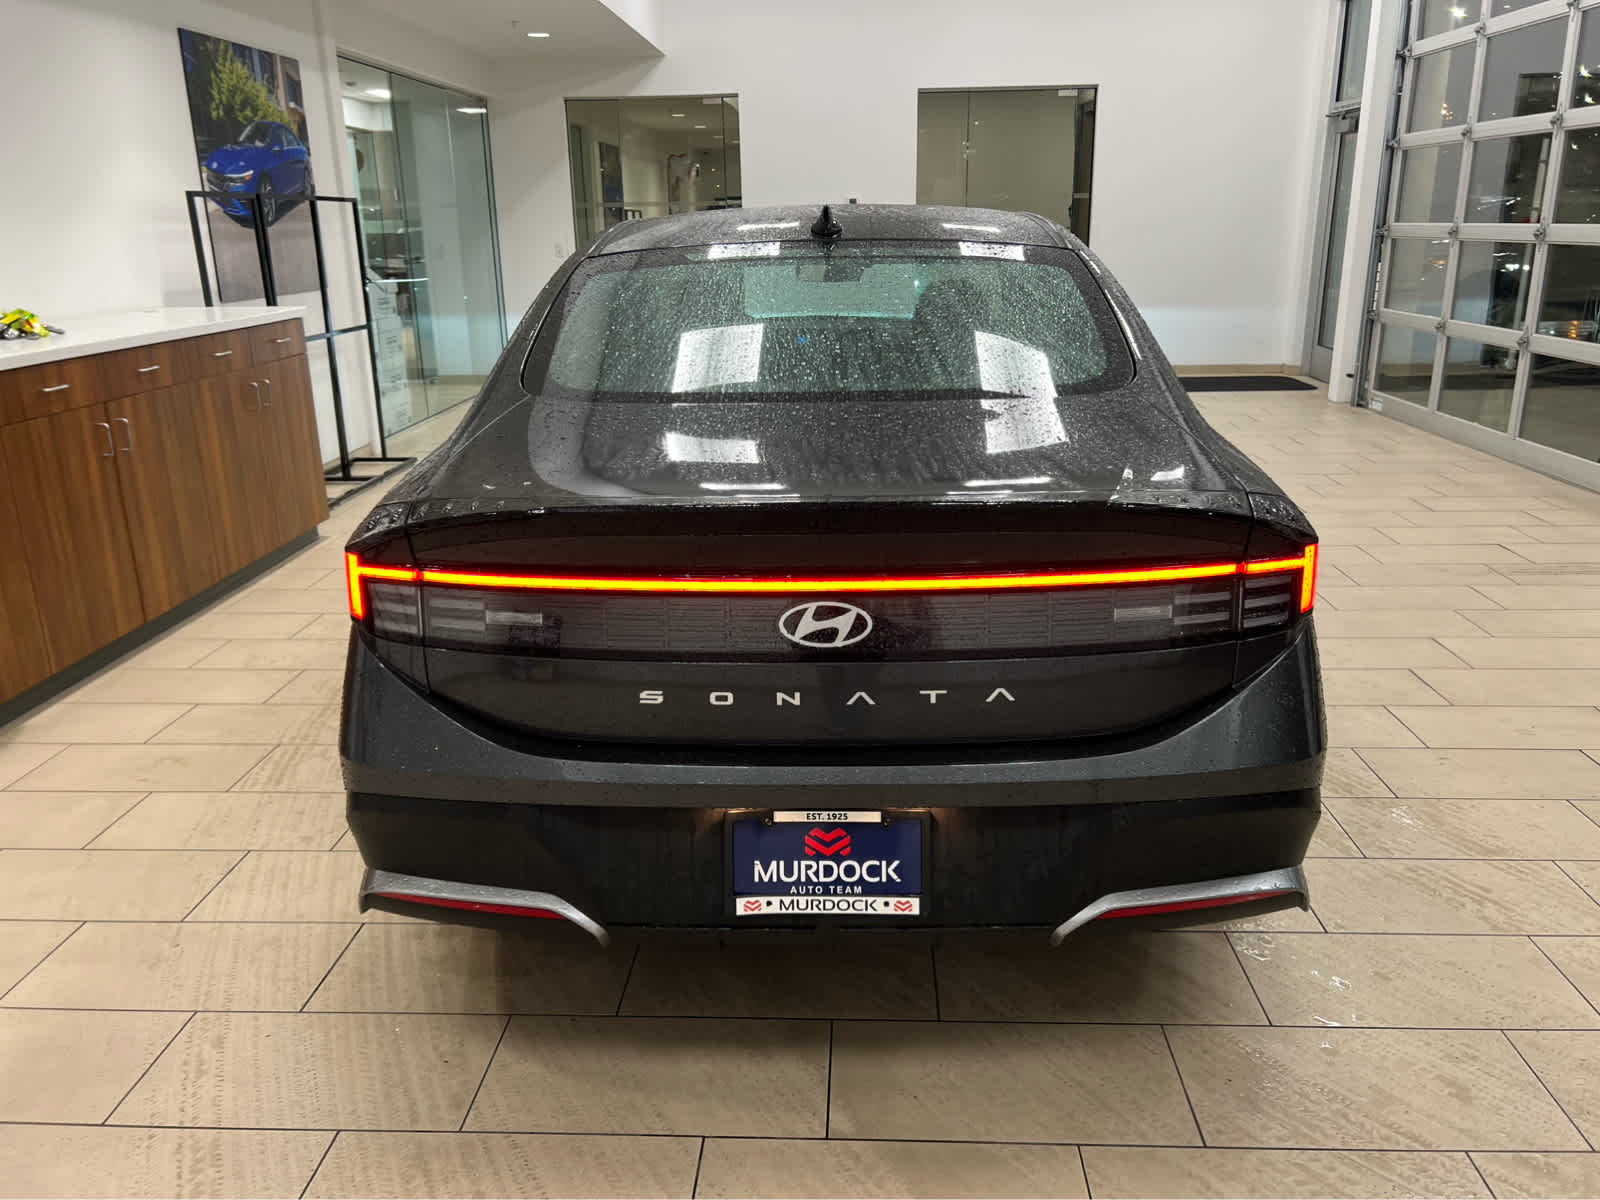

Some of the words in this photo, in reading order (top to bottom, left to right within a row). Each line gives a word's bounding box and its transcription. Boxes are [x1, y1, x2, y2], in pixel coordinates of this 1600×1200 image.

[639, 688, 1017, 706] SONATA
[806, 812, 824, 821] EST.
[826, 812, 849, 821] 1925
[754, 860, 901, 882] MURDOCK
[790, 885, 822, 894] AUTO
[830, 885, 863, 894] TEAM
[779, 898, 877, 912] MURDOCK
